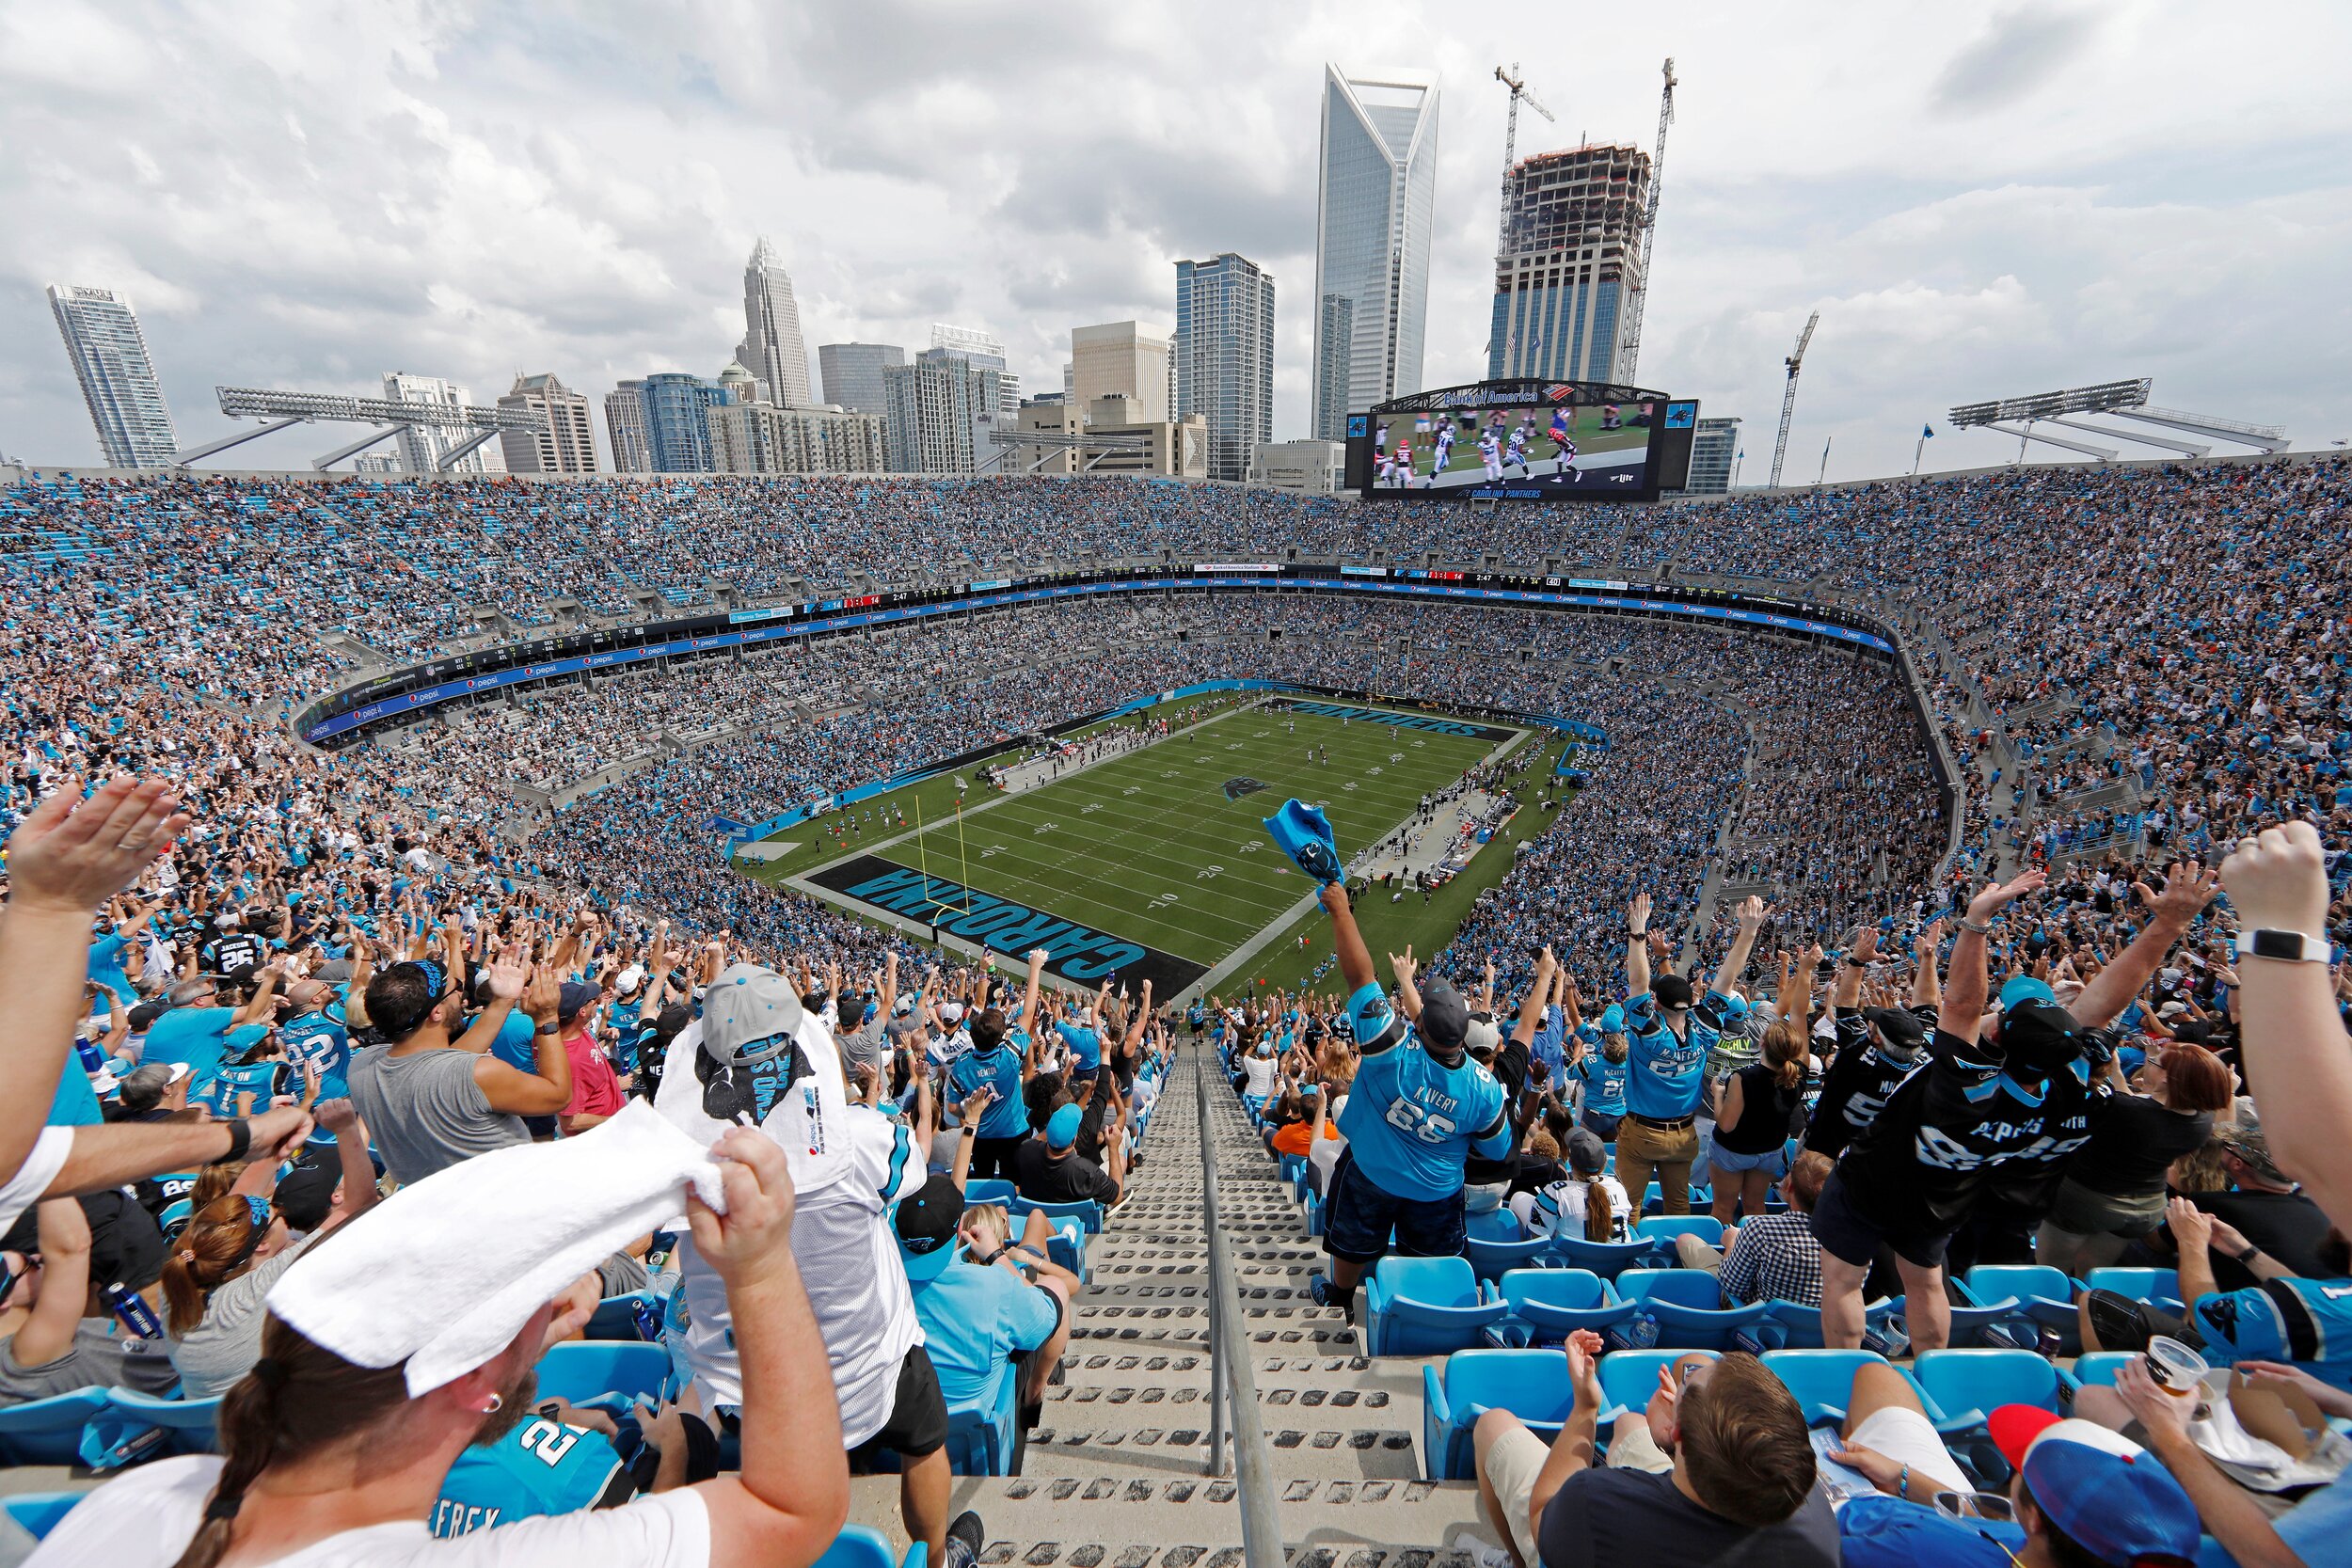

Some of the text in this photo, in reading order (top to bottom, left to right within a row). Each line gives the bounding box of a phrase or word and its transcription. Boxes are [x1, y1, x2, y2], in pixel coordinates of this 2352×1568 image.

[84, 288, 111, 297] VUE
[1444, 390, 1537, 404] Bank of America
[1505, 489, 1540, 498] PANTHERS
[893, 593, 907, 601] 2:47
[794, 625, 808, 633] pepsi
[700, 639, 718, 647] pepsi
[648, 646, 666, 656] pepsi
[594, 655, 613, 664] pepsi
[535, 665, 557, 675] pepsi
[477, 676, 499, 688] pepsi
[420, 689, 439, 702] pepsi
[362, 705, 383, 718] pepsi
[1281, 702, 1487, 737] PANTHERS
[310, 723, 330, 737] pepsi
[1084, 802, 1104, 813] 30
[1037, 822, 1058, 833] 20
[985, 845, 1009, 858] 10
[1242, 840, 1264, 852] 30
[1200, 864, 1224, 879] 20
[1152, 893, 1179, 909] 10
[844, 868, 1146, 979] CAROLINA
[221, 941, 249, 952] JACKSON
[220, 949, 254, 973] 26
[285, 1034, 340, 1079] 22
[977, 1067, 997, 1077] NEWTON
[219, 1083, 235, 1113] 1
[985, 1081, 1004, 1102] 1
[753, 1076, 777, 1121] TWO
[1385, 1096, 1458, 1144] 66
[428, 1497, 502, 1541] FREY
